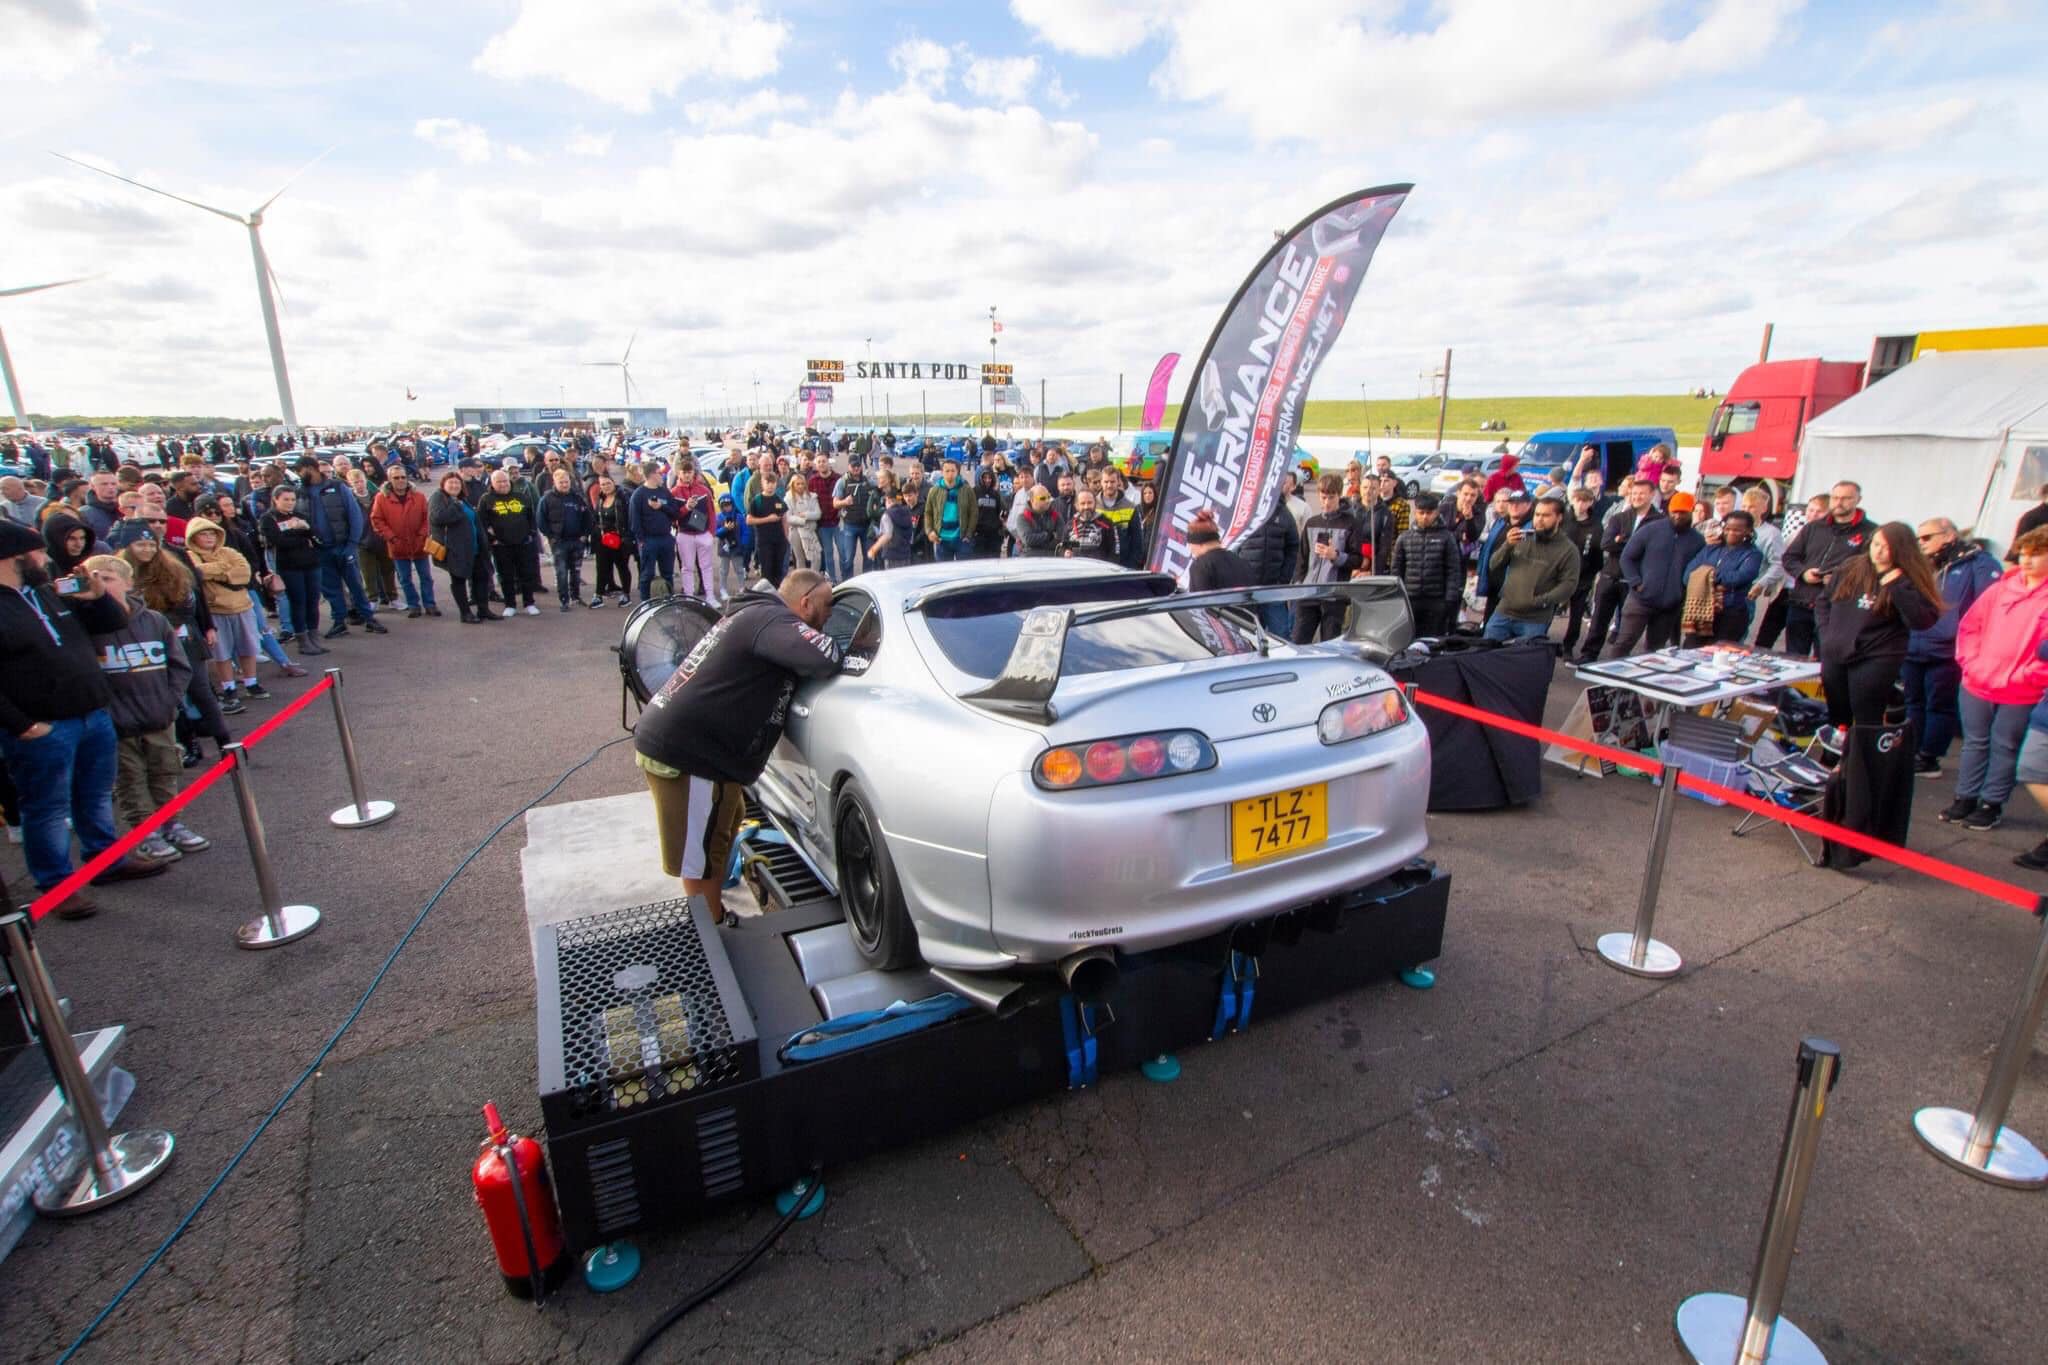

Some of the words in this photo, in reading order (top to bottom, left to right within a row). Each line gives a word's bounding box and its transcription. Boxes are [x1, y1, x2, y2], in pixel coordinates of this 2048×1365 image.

[857, 361, 922, 379] SANTA
[932, 363, 968, 380] POD
[1243, 439, 1267, 489] EXHAUSTS
[1297, 299, 1314, 319] AND
[1258, 790, 1303, 822] TLZ
[1251, 816, 1311, 852] 7477
